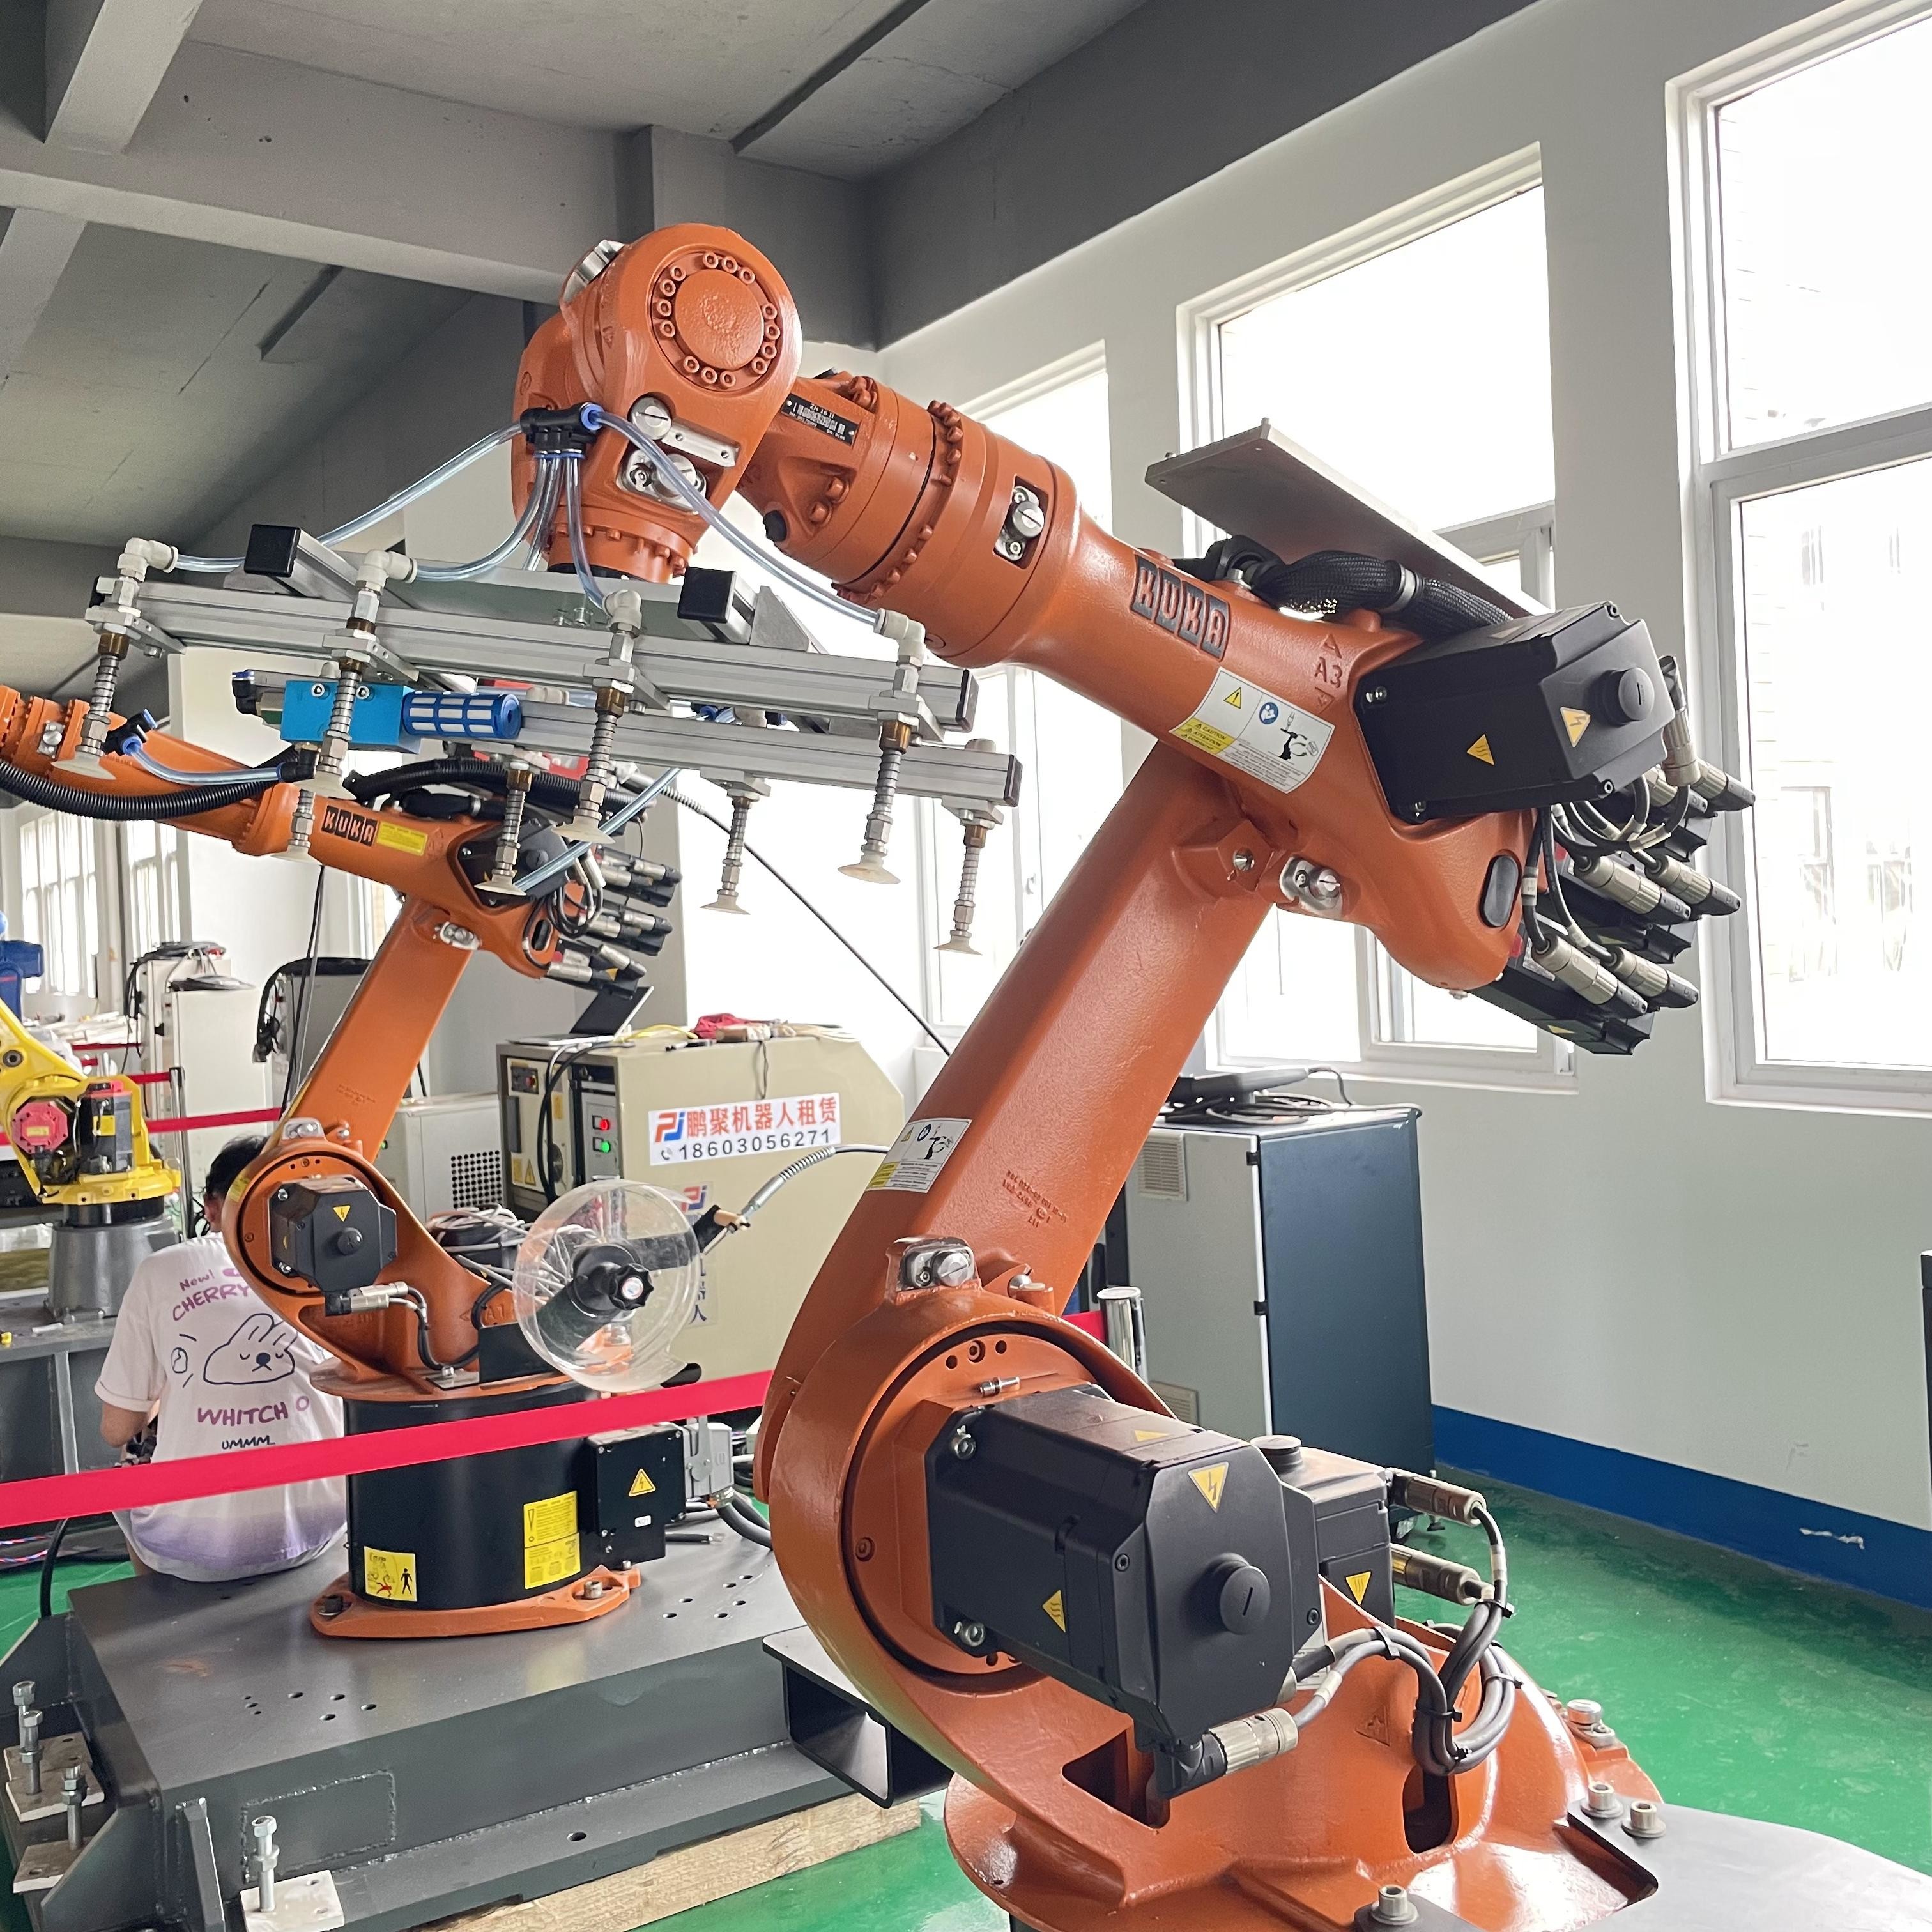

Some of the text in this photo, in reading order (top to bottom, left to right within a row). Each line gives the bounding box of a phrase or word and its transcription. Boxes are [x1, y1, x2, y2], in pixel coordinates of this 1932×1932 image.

[1136, 564, 1227, 650] KUKA
[1314, 656, 1343, 689] A3
[1202, 726, 1227, 740] CAUTION
[323, 809, 376, 843] KUKA
[686, 1096, 837, 1138] 鹏聚机器人租赁
[679, 1128, 831, 1160] 18603056271
[172, 1284, 250, 1321] CHERRY
[197, 1402, 289, 1427] WHITCH
